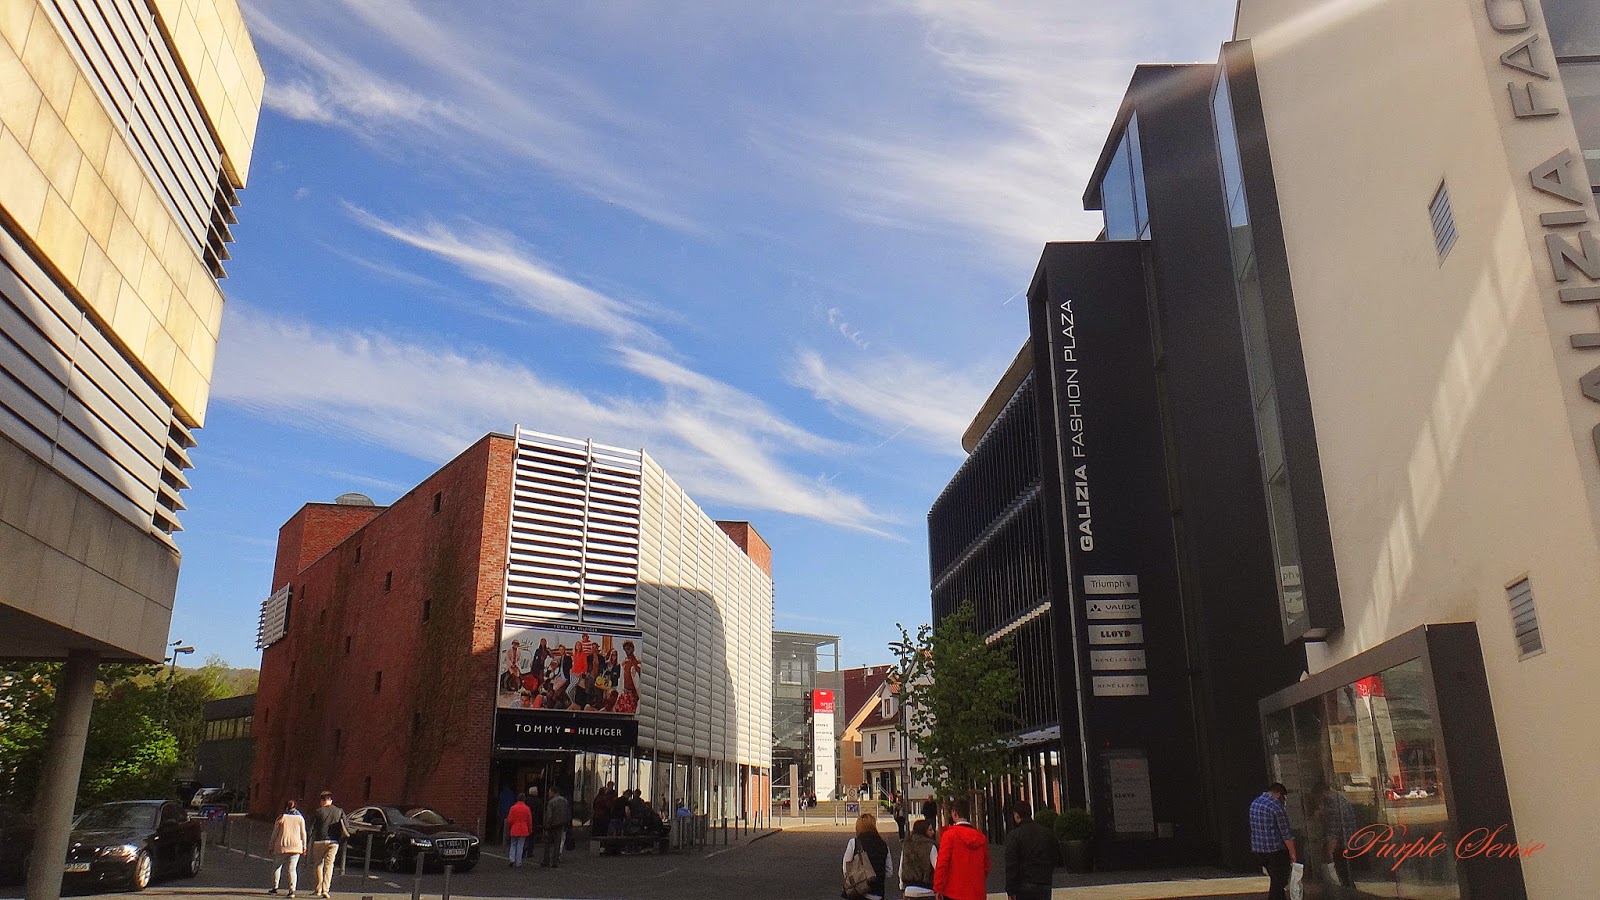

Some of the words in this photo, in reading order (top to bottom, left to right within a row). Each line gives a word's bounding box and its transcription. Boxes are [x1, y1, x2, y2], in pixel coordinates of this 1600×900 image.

[1060, 299, 1077, 362] PLAZA
[1066, 368, 1086, 458] FASHION
[1074, 464, 1094, 552] GALIZIA
[1090, 580, 1125, 589] Triumph
[1100, 630, 1131, 638] LLOYD
[515, 723, 561, 734] TOMMY
[578, 727, 622, 737] HILFIGER
